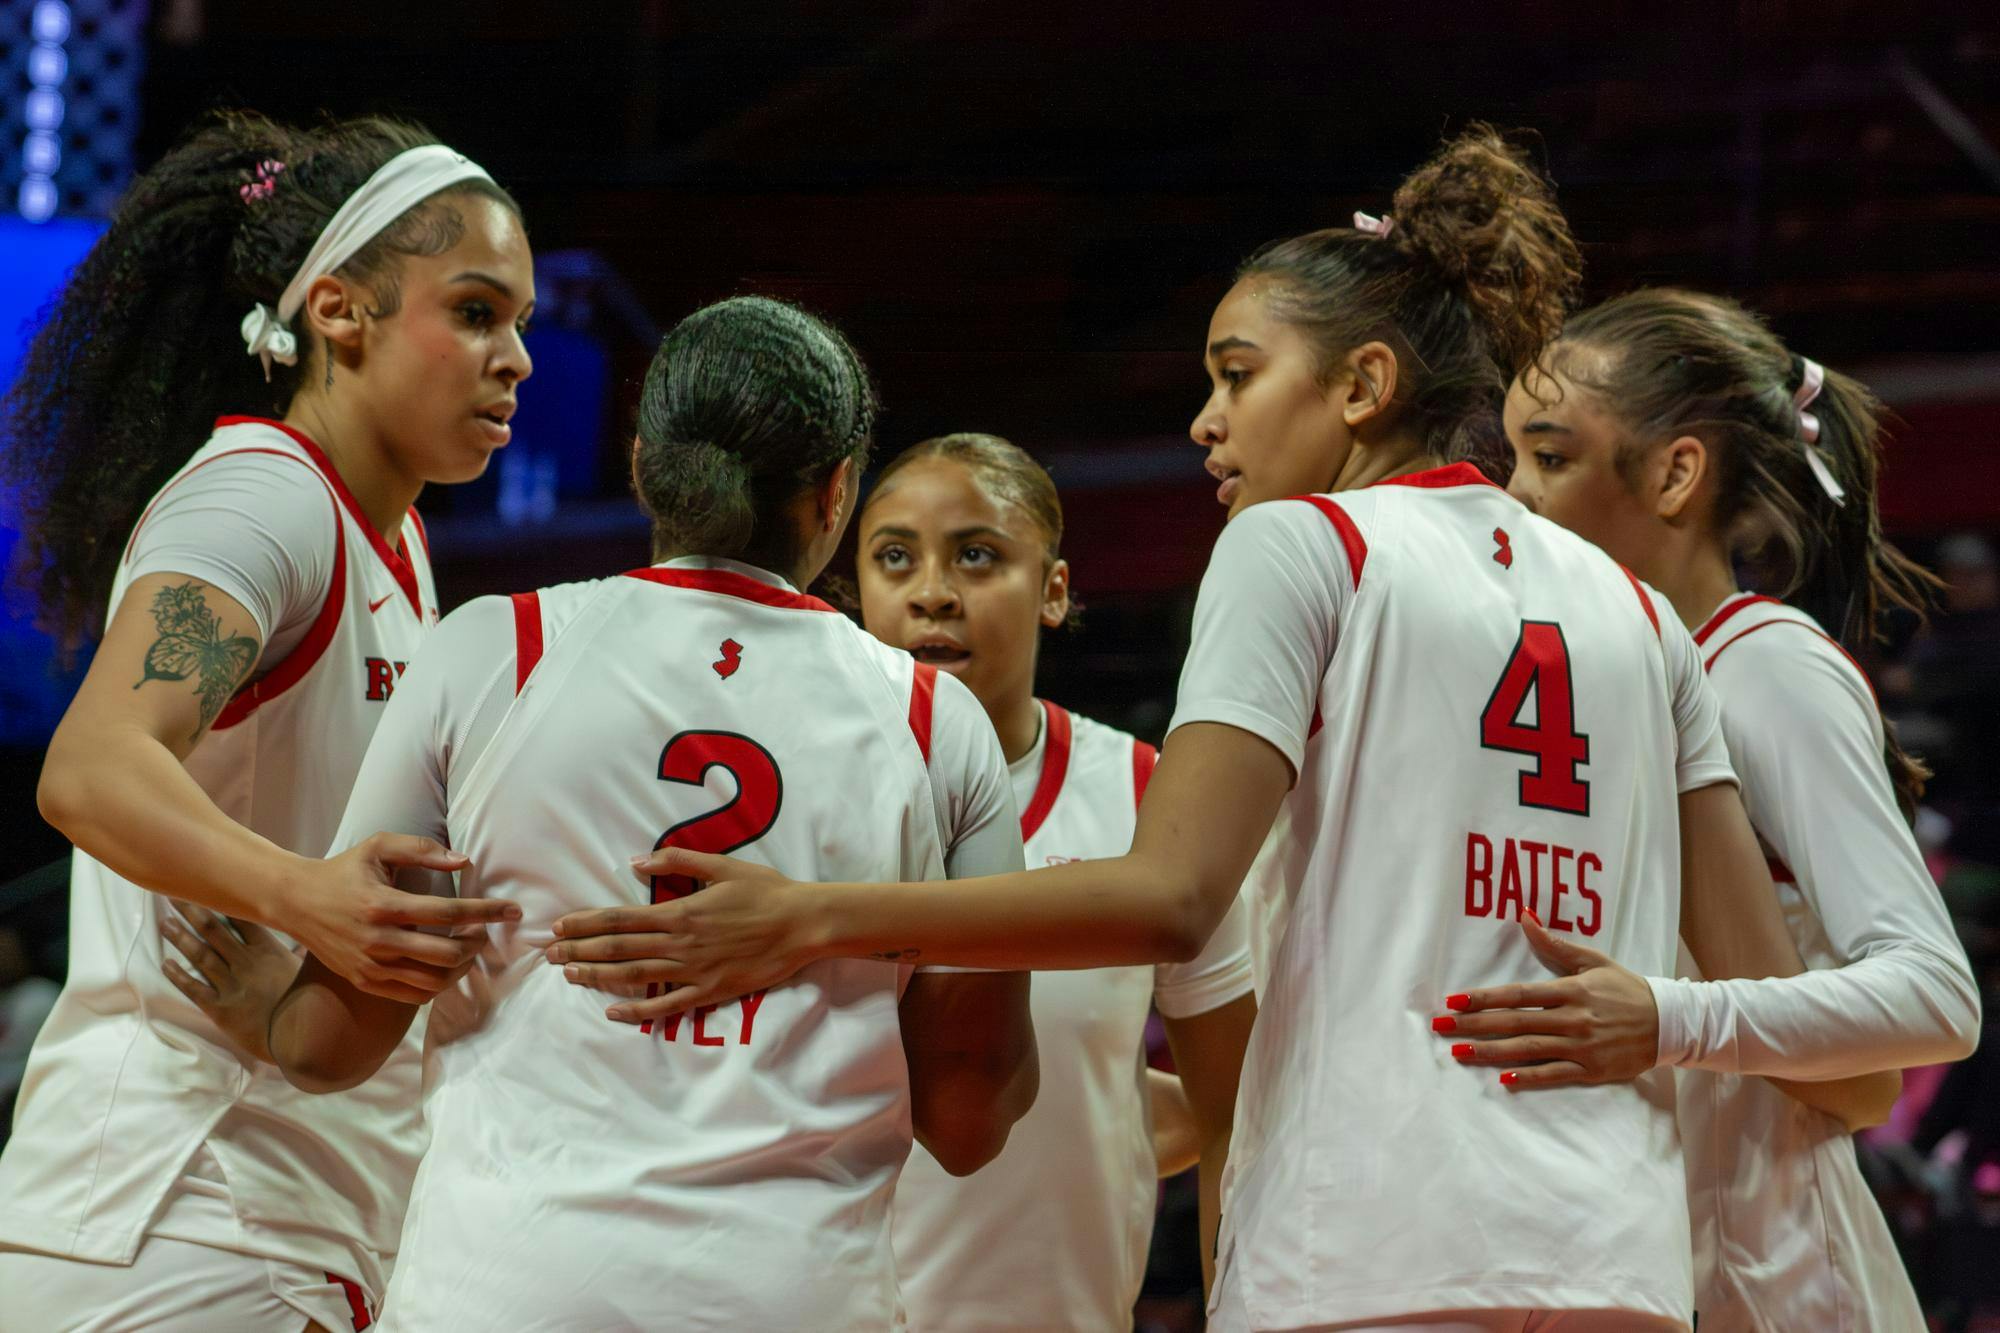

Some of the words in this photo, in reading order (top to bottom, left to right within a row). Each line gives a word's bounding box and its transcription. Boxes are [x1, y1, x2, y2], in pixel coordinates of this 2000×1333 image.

[364, 657, 409, 702] R
[1480, 618, 1590, 817] 4
[650, 729, 783, 905] 2
[1465, 832, 1602, 937] BATES
